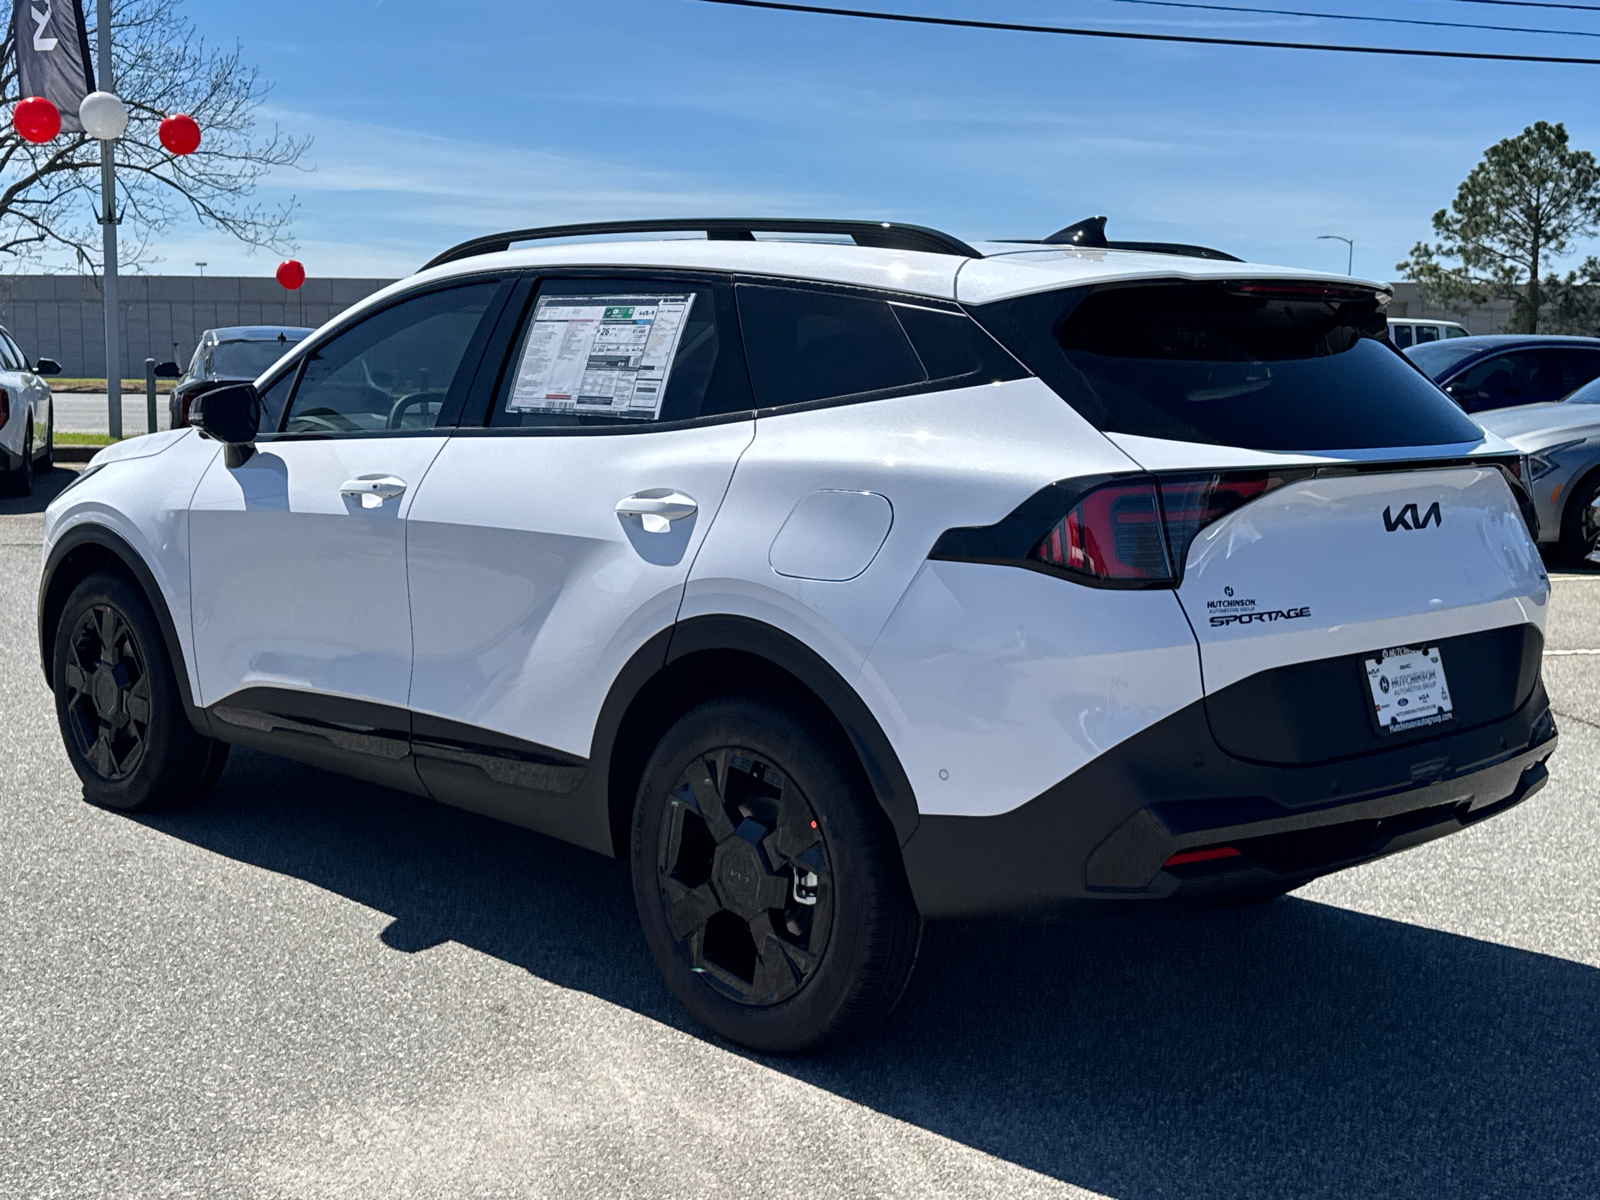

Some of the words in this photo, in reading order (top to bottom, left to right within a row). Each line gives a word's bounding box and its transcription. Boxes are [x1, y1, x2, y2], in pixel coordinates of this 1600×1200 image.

[1382, 501, 1442, 532] KIA
[1207, 599, 1256, 609] HUTCHINSON
[1209, 606, 1312, 627] SPORTAGE
[1391, 669, 1436, 688] HUTCHINSON
